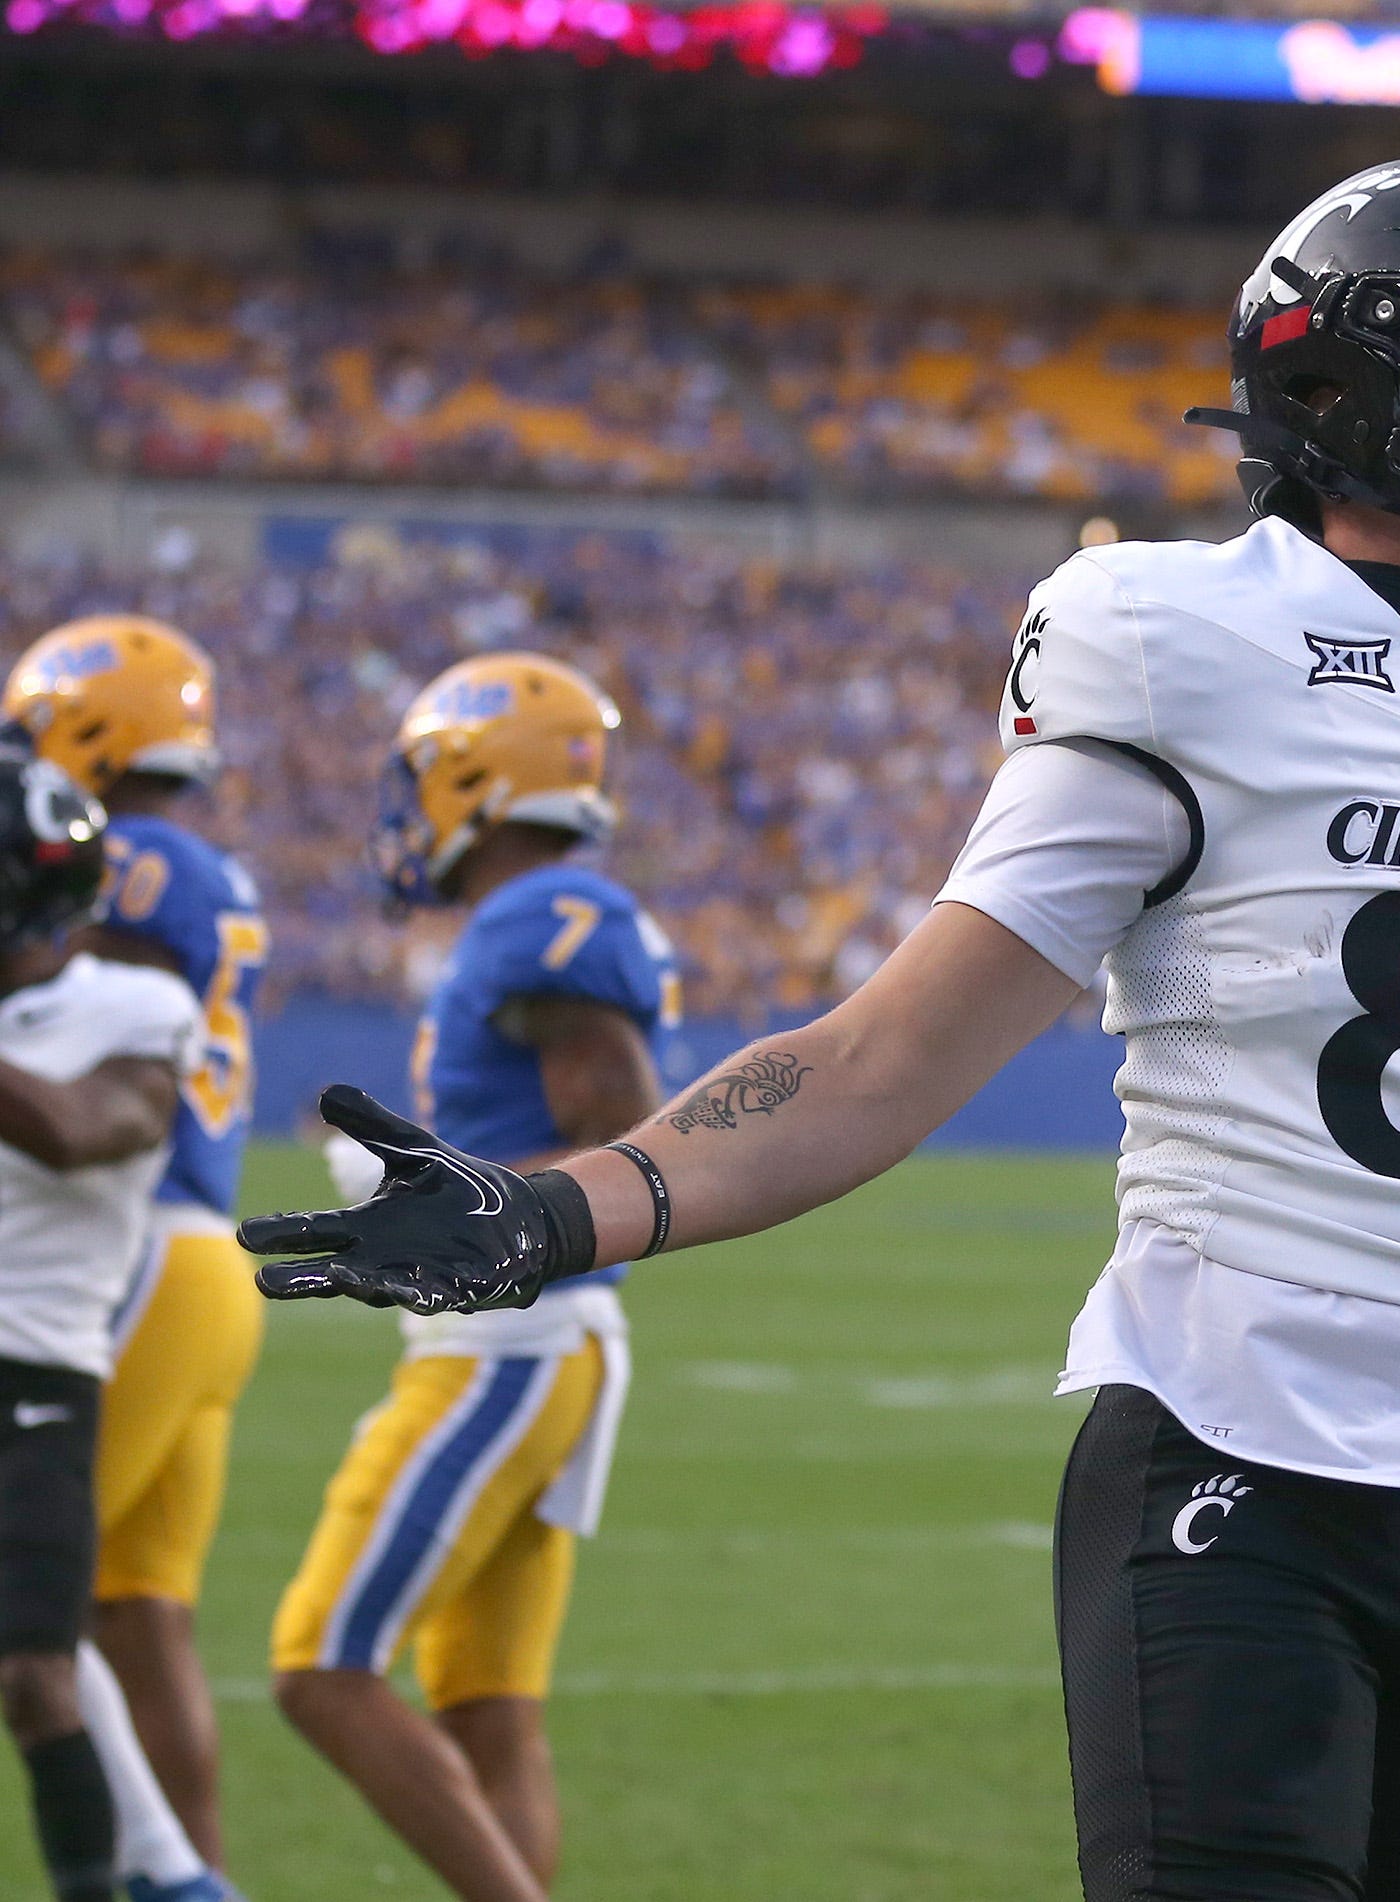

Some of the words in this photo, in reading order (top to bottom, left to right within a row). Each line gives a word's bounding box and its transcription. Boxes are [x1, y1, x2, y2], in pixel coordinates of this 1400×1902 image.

[1304, 632, 1395, 692] XII
[541, 894, 601, 971] 7
[650, 1172, 665, 1198] EAT
